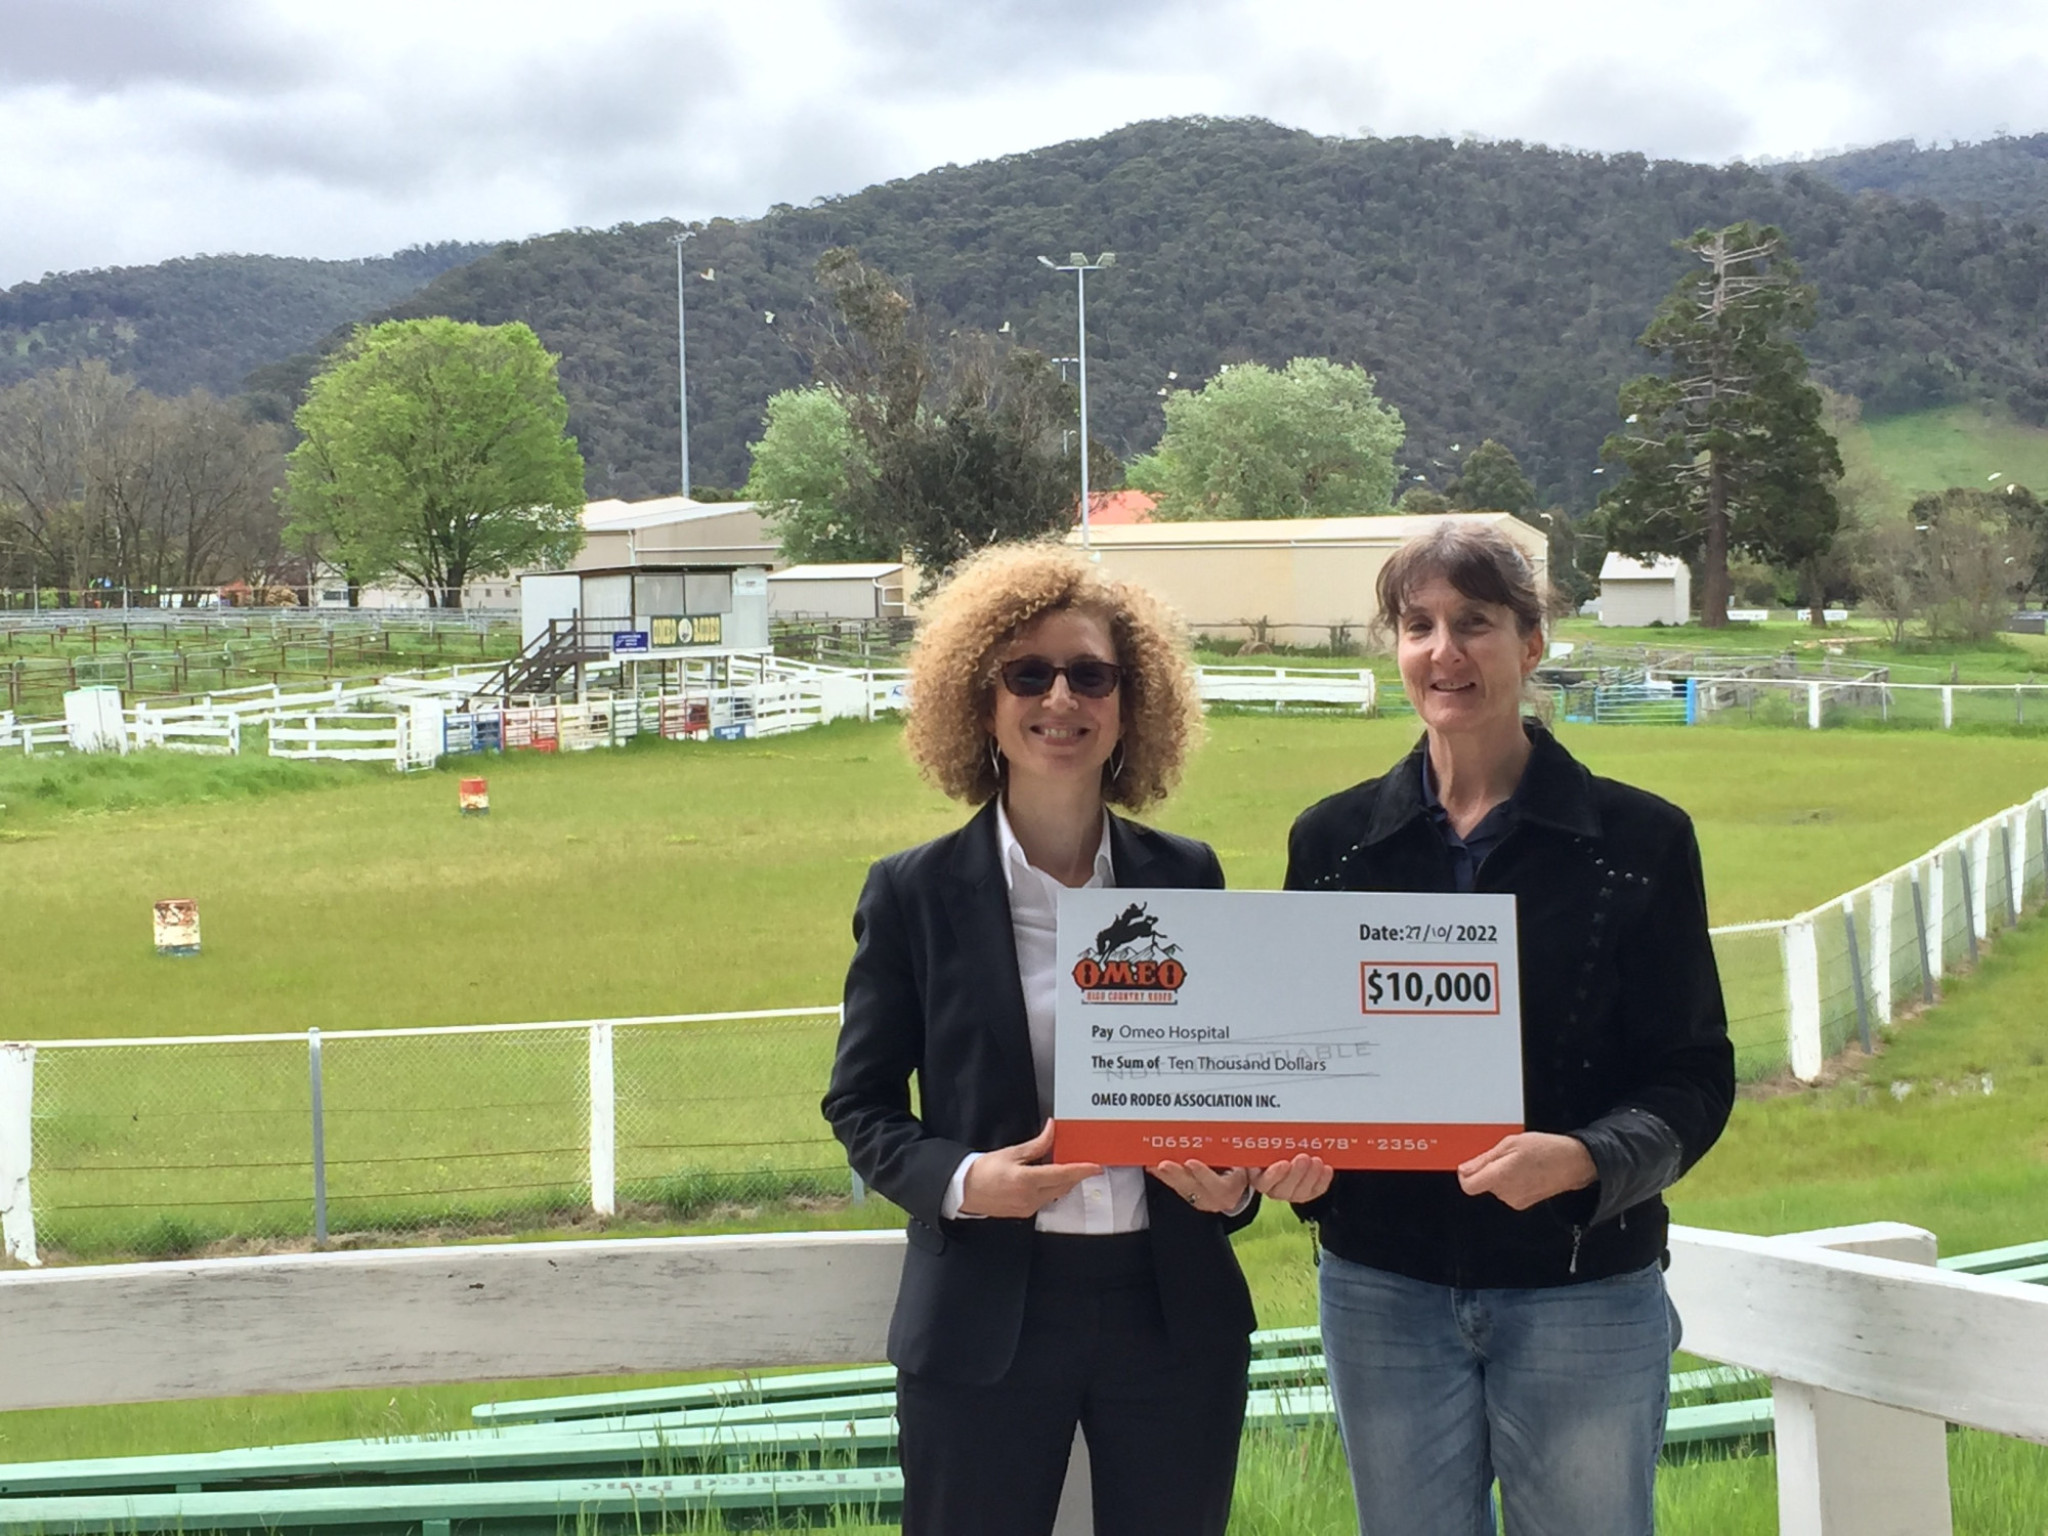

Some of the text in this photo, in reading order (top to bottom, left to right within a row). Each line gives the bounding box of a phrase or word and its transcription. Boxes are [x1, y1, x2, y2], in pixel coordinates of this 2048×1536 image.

[1072, 957, 1187, 989] OMEO
[1367, 968, 1491, 1007] $10,000
[1091, 1025, 1230, 1042] Pay Omeo Hospital
[1091, 1056, 1327, 1072] The Sum of Ten Thousand Dollars
[1091, 1092, 1281, 1108] OMEO RODEO ASSOCIATION INC.
